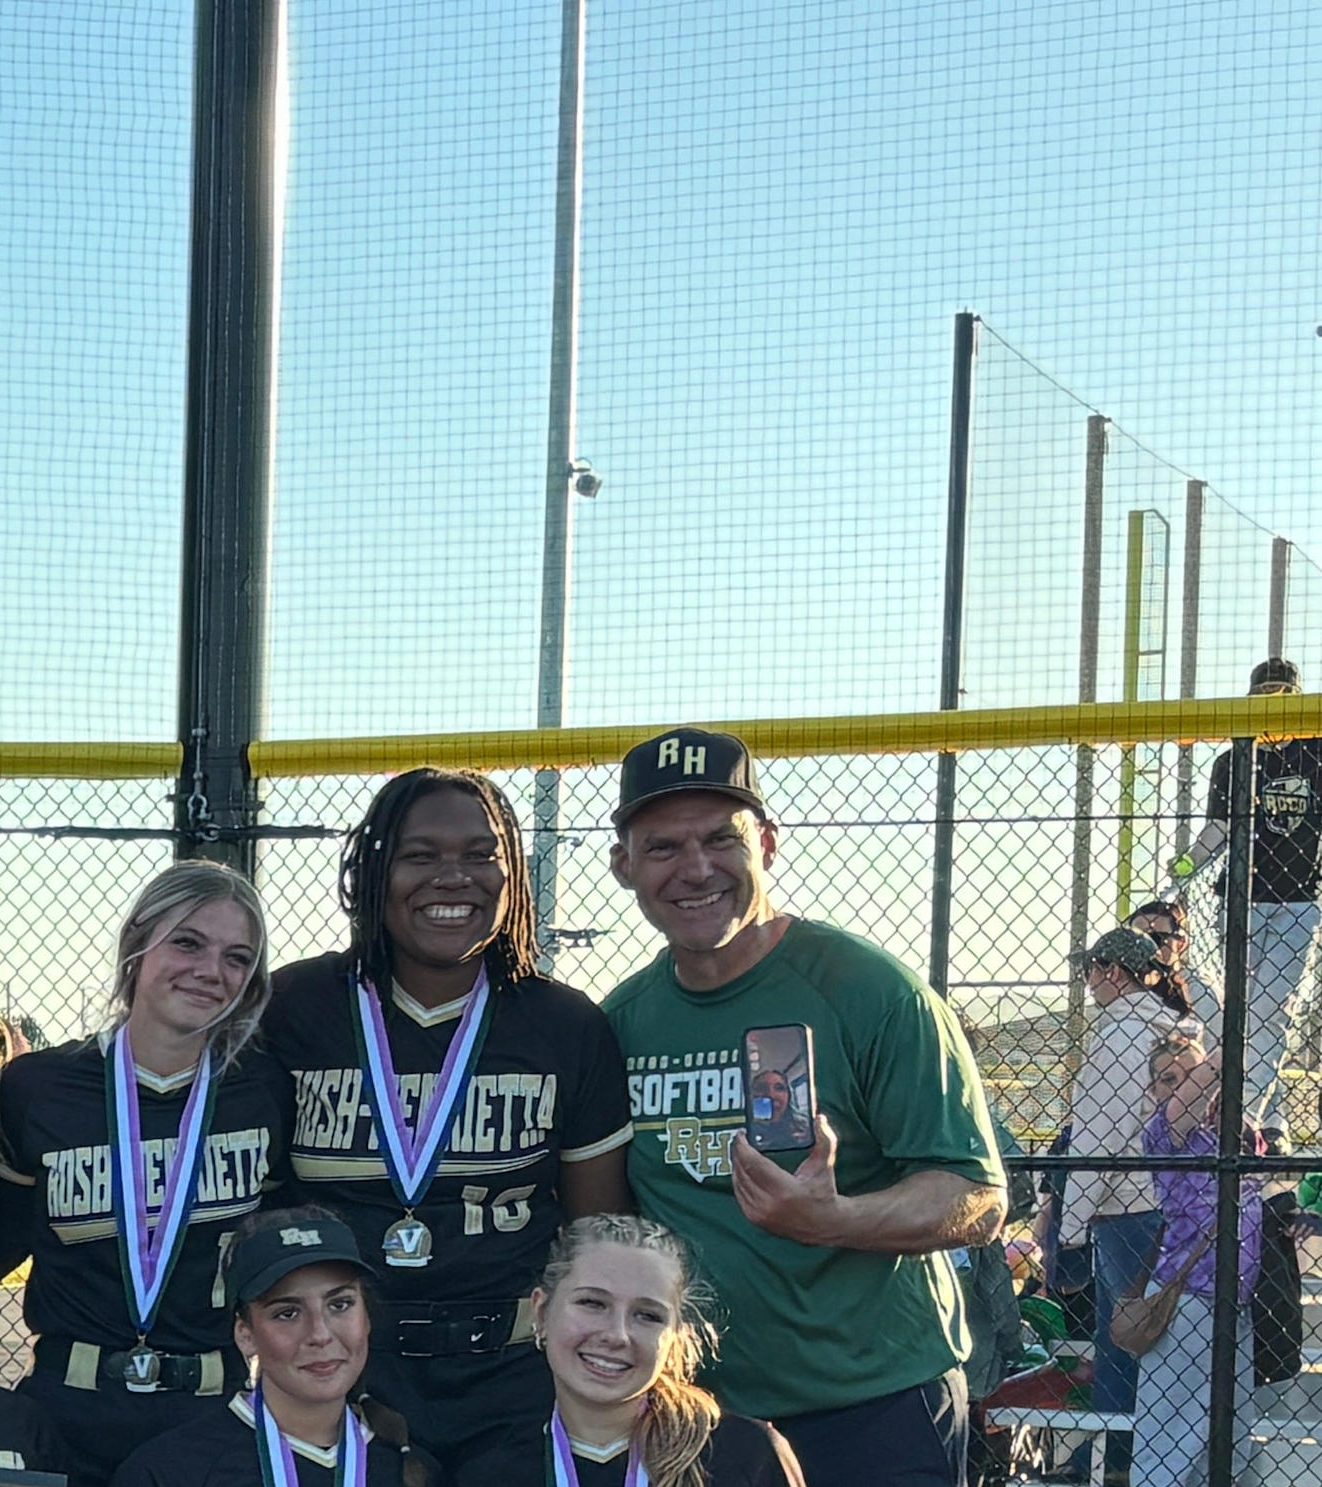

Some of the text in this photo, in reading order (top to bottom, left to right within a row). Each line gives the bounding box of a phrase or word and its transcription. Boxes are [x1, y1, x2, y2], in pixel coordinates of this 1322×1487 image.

[658, 738, 706, 775] RH
[628, 1066, 745, 1117] SOFTBA
[665, 1117, 734, 1176] RH
